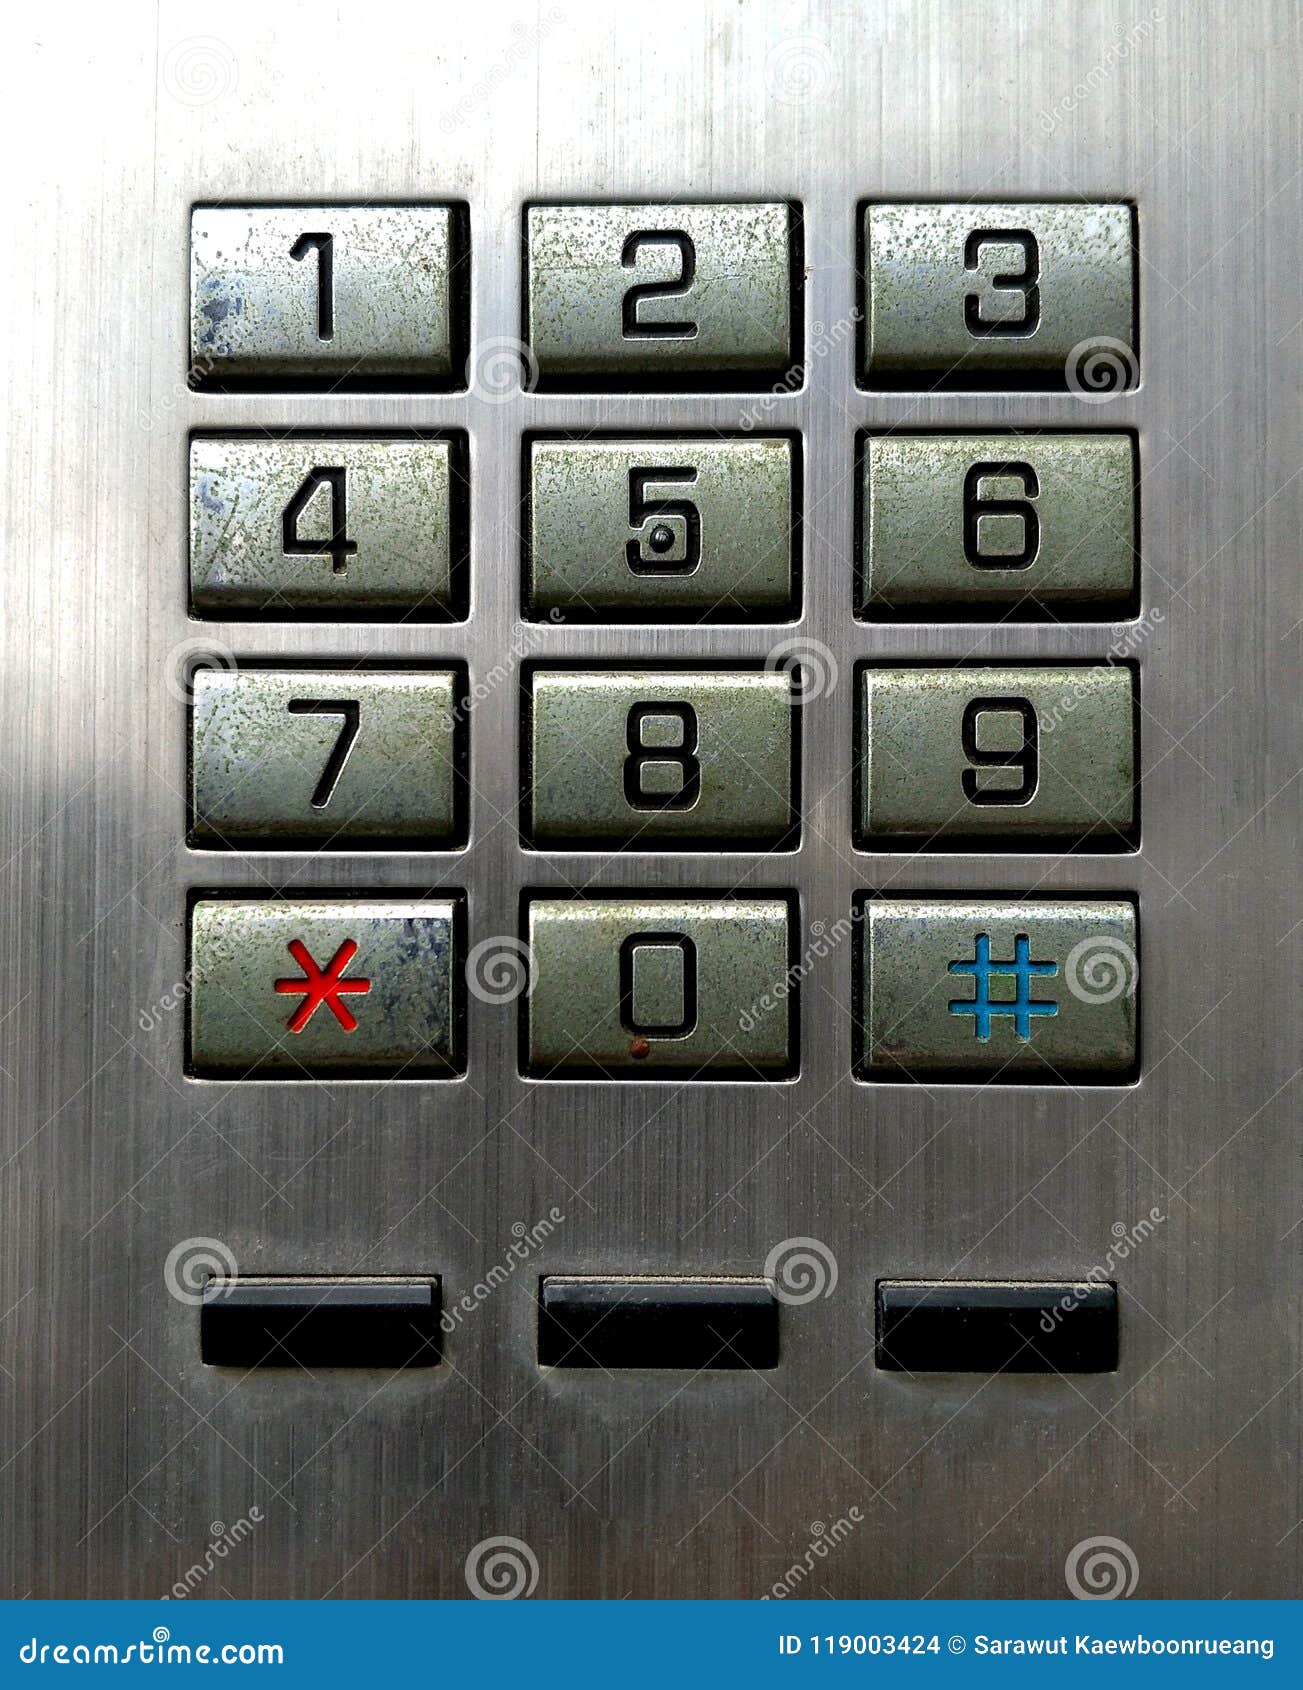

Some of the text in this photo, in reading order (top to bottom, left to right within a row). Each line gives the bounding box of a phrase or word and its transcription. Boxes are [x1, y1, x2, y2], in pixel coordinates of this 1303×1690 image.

[289, 231, 335, 342] 1
[620, 228, 699, 340] 2
[963, 227, 1042, 340] 3
[281, 465, 358, 575] 4
[625, 465, 702, 577] 5
[962, 461, 1041, 571] 6
[286, 698, 362, 809] 7
[622, 700, 702, 812] 8
[960, 696, 1040, 807] 9
[618, 931, 699, 1041] 0
